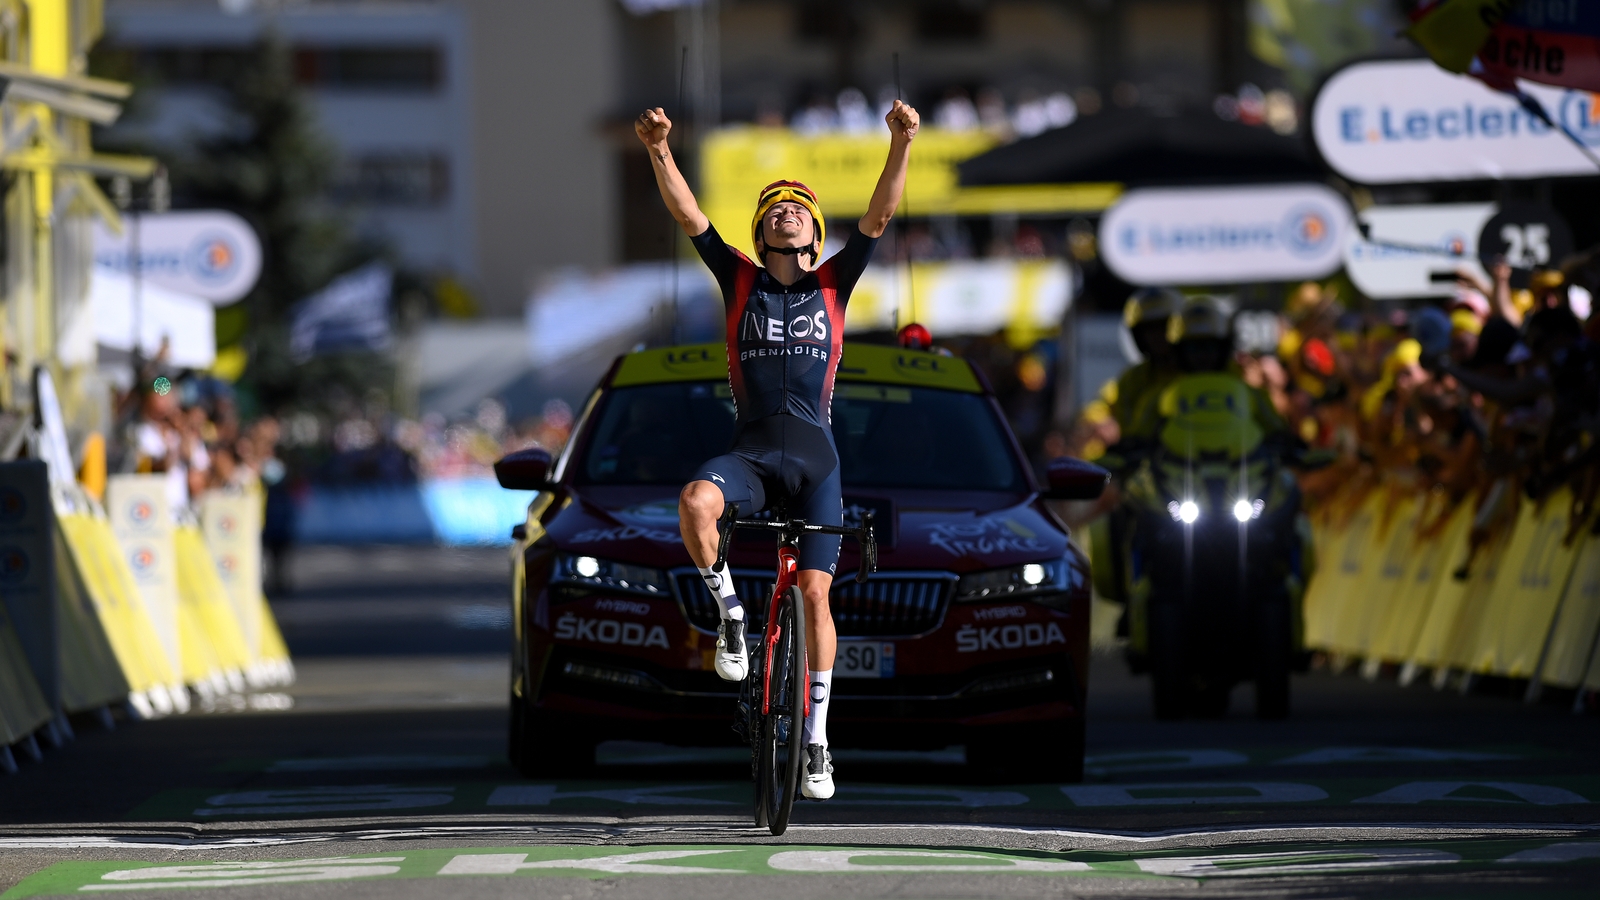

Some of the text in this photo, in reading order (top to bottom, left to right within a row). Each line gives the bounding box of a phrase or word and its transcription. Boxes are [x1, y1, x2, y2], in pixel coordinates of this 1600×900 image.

[1500, 222, 1551, 270] 25
[742, 309, 828, 342] INEOS
[666, 350, 717, 364] LCL
[741, 346, 828, 362] GRENADIER
[898, 355, 946, 371] LCL
[594, 599, 650, 616] HYBRID
[972, 605, 1028, 622] HYBRID
[553, 611, 671, 650] ŠKODA
[954, 621, 1068, 653] ŠKODA
